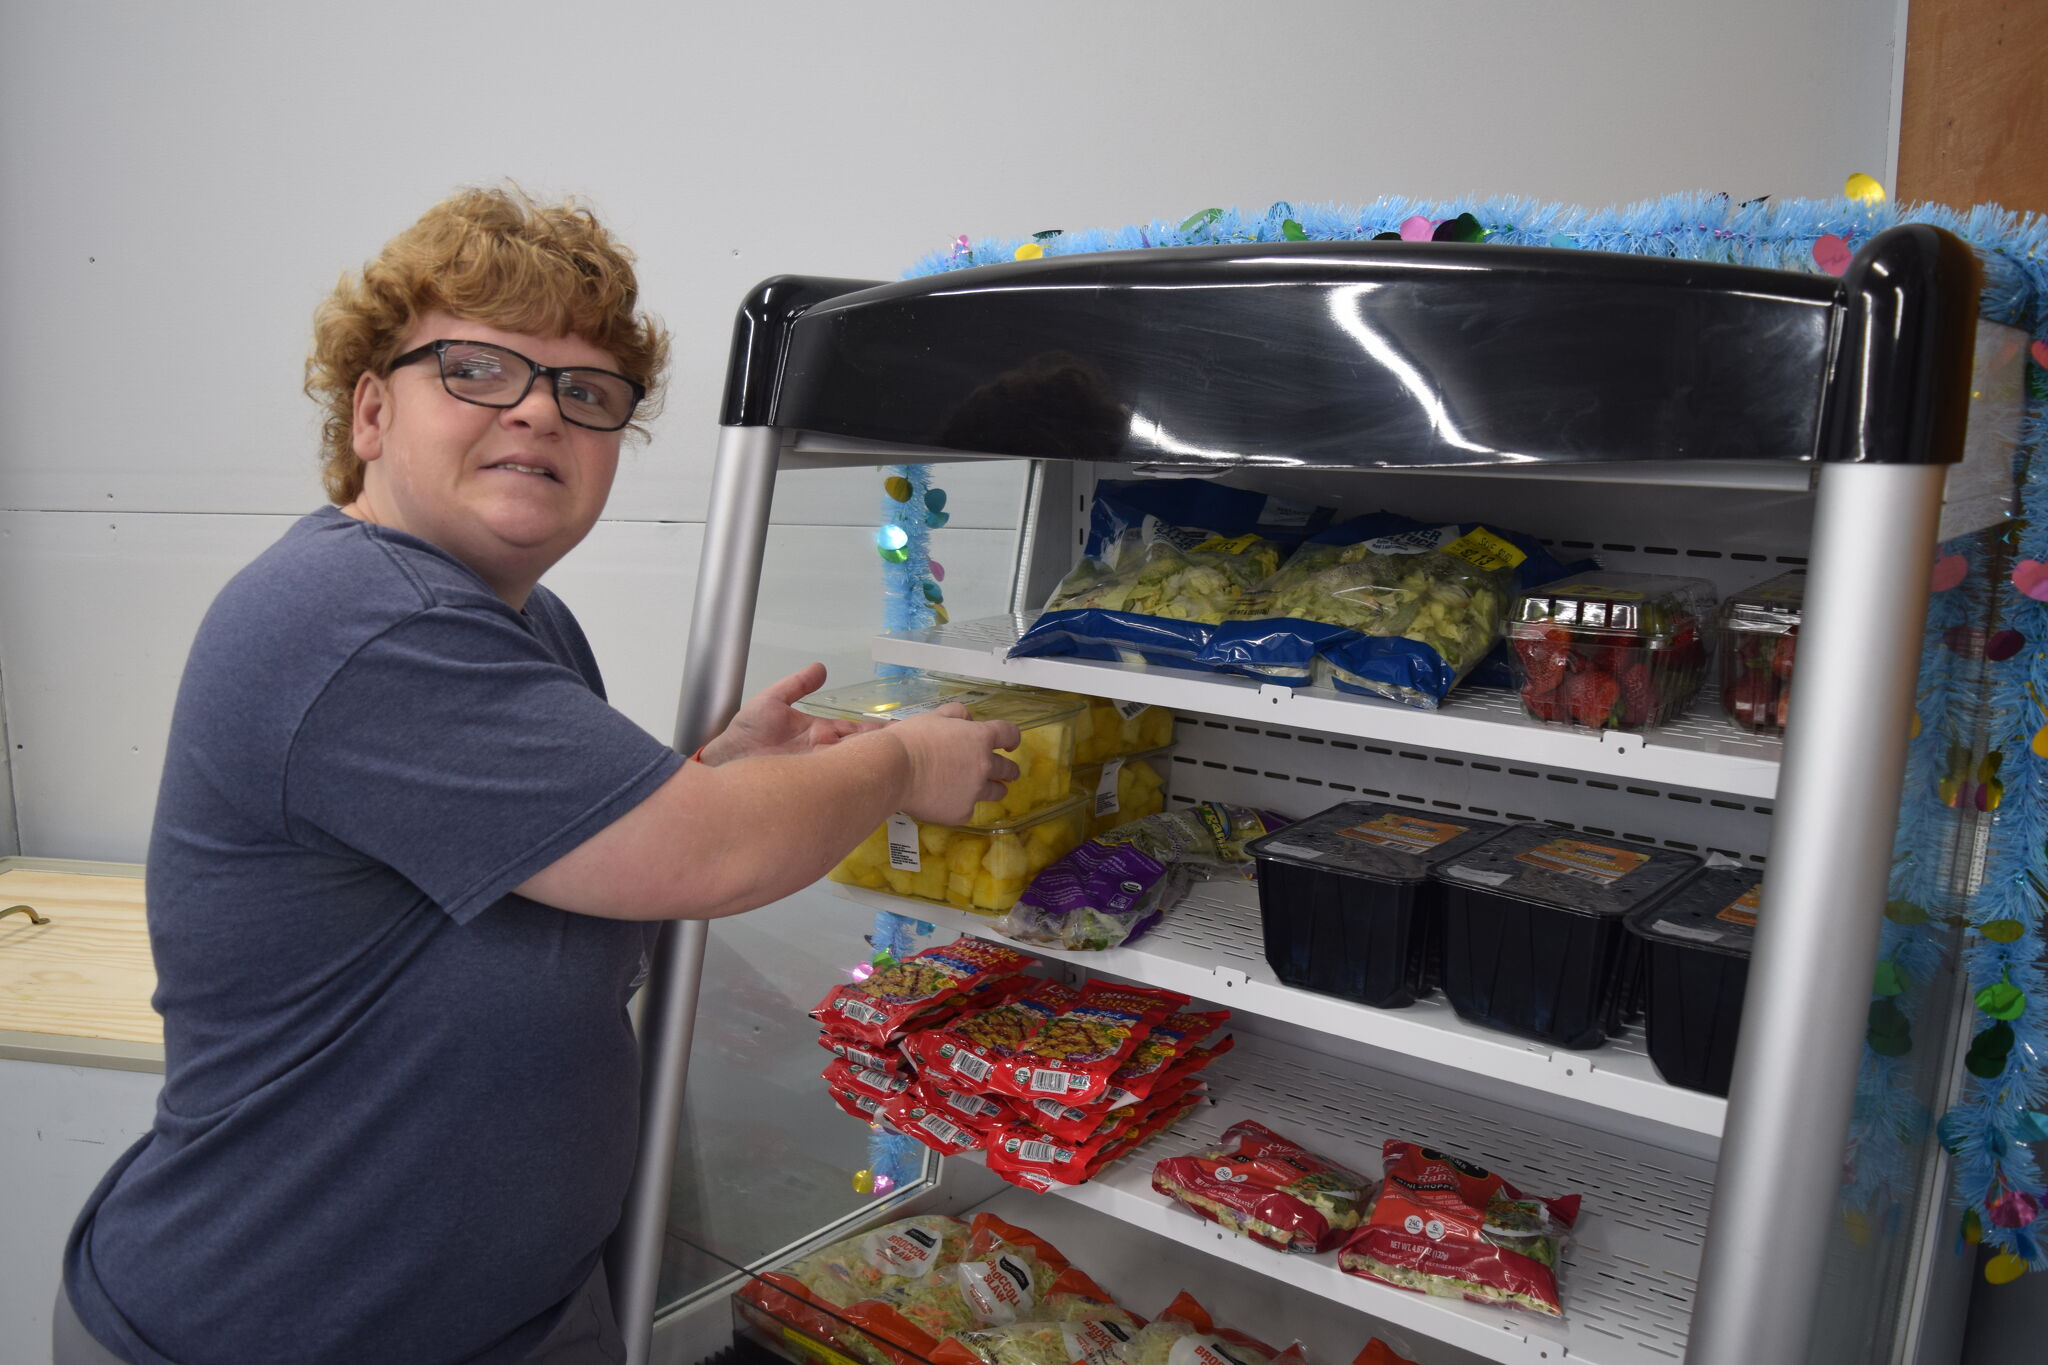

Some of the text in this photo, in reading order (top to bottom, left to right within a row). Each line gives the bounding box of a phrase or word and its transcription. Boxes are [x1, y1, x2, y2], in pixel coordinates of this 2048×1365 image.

[887, 1235, 931, 1262] BROCCOLI
[889, 1245, 915, 1262] SLAW
[1390, 1240, 1401, 1250] NET
[983, 1274, 1007, 1304] SLAW
[986, 1259, 1021, 1307] BROCCOLI
